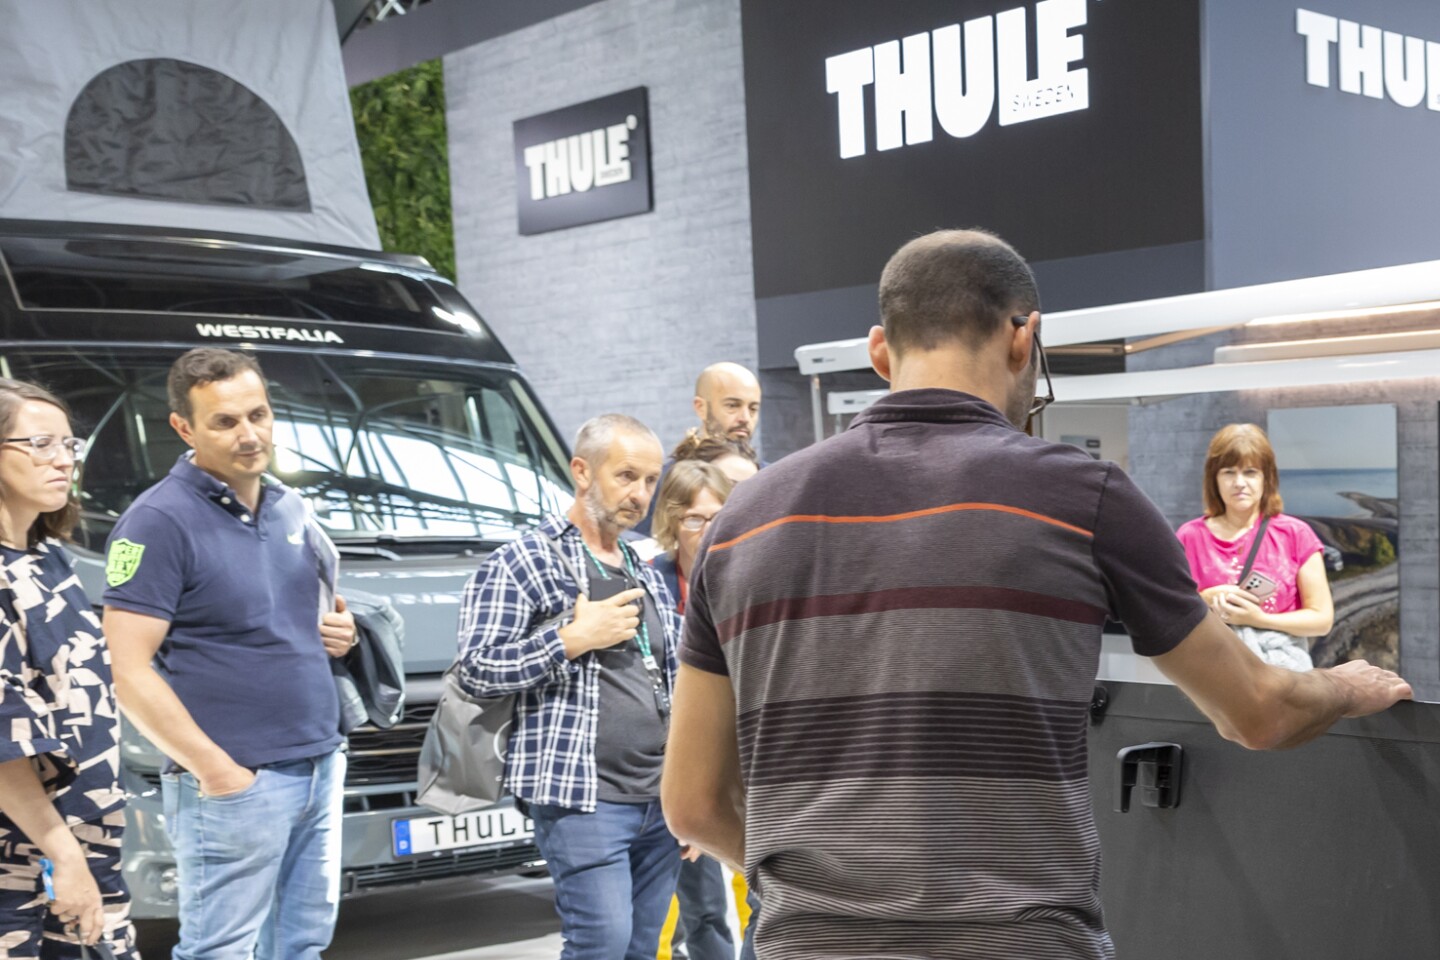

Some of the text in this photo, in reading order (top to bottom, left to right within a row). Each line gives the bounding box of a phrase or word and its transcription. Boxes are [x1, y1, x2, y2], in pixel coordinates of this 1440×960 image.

[825, 0, 1089, 159] THULE
[1012, 84, 1075, 113] SWEDEN
[524, 122, 632, 201] THULE
[195, 323, 345, 344] WESTFALIA
